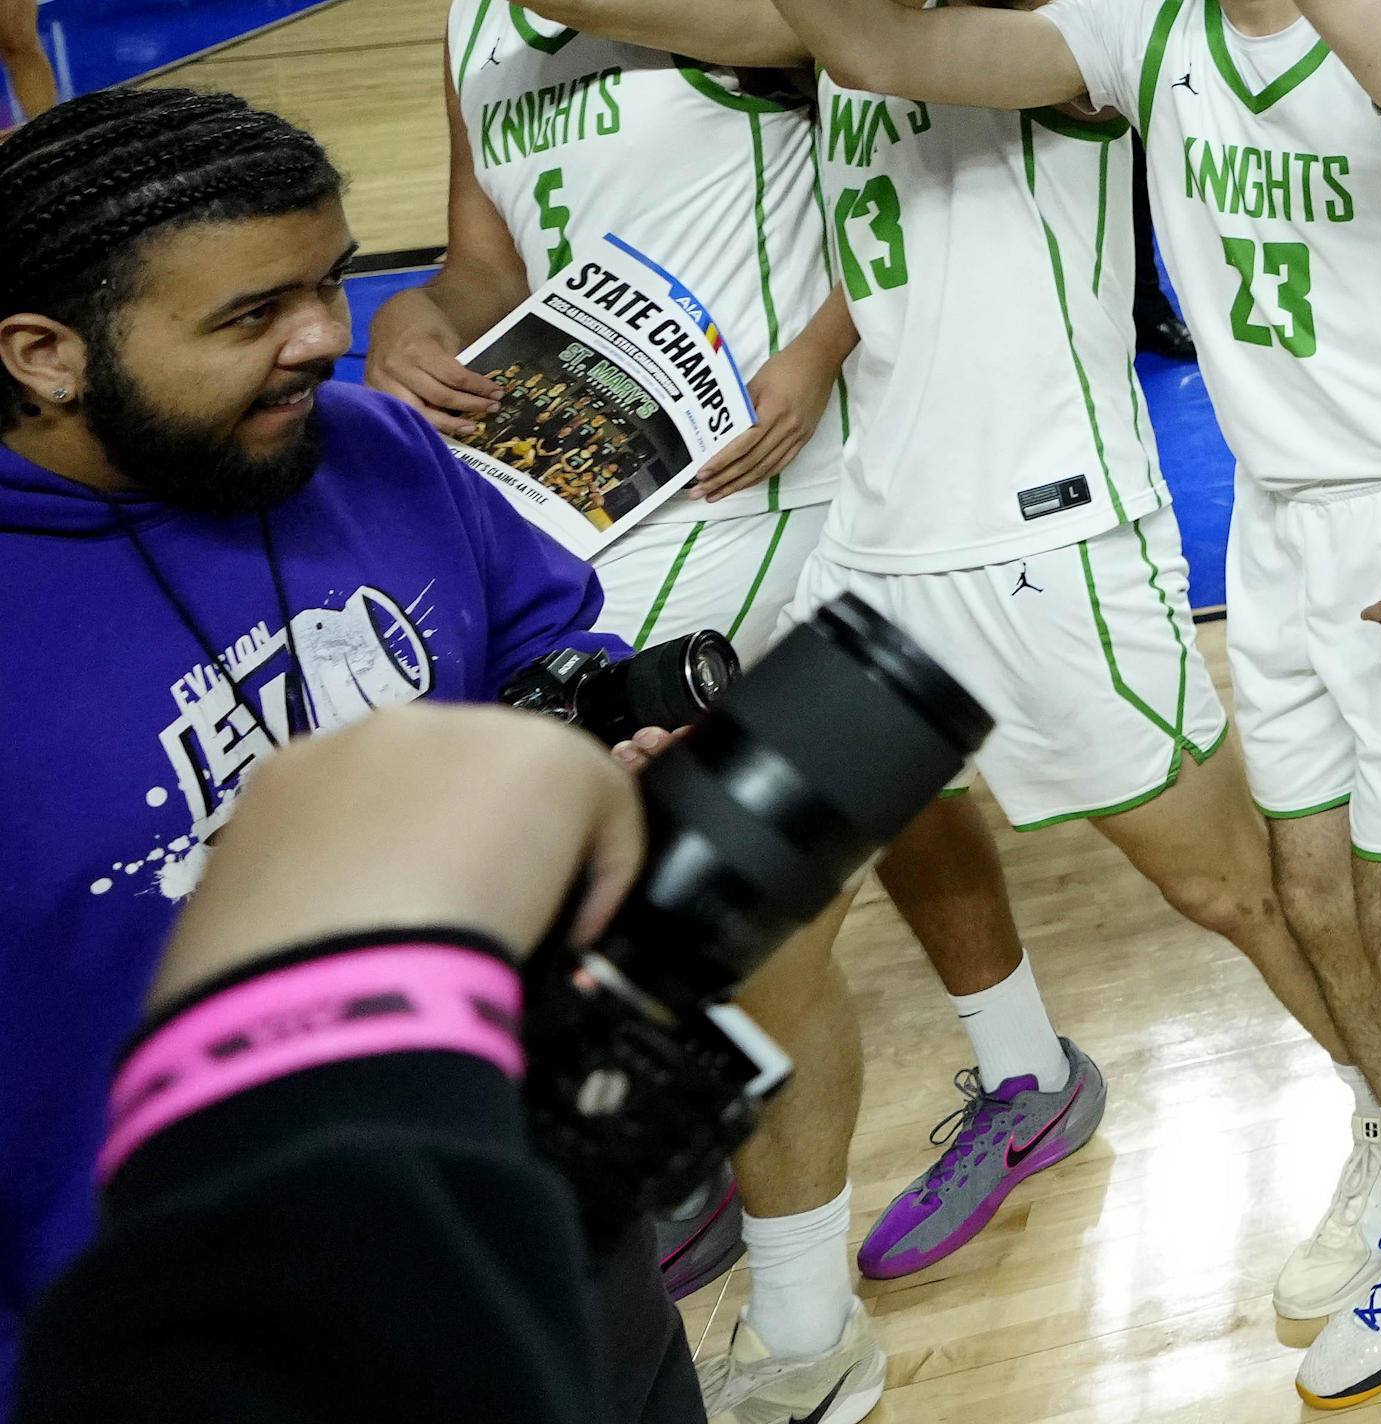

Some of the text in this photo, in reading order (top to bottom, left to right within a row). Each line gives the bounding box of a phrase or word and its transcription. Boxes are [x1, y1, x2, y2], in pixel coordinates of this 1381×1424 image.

[481, 67, 622, 168] KNIGHTS
[1184, 135, 1354, 223] KNIGHTS
[835, 175, 908, 302] 13
[675, 296, 702, 323] AIA
[1221, 236, 1317, 359] 23
[559, 342, 590, 374] ST.
[588, 359, 660, 420] MARY'S
[566, 262, 663, 331] STATE
[648, 319, 734, 442] CHAMPS!
